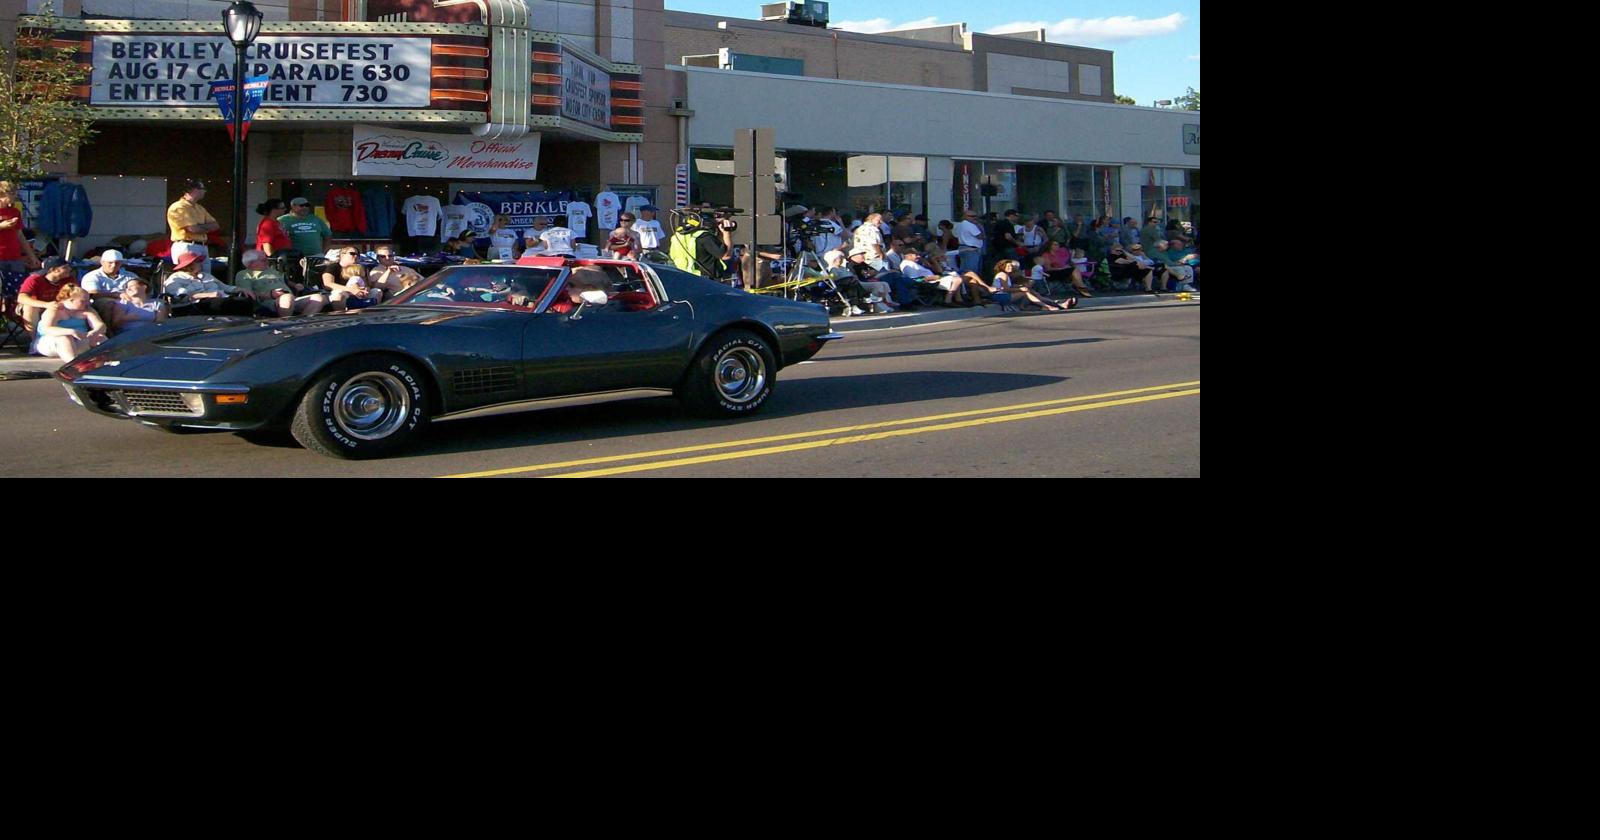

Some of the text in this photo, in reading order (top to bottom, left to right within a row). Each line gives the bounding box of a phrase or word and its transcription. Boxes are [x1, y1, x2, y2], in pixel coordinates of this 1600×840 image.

[111, 42, 394, 61] BERKLEY CRUISEFEST
[108, 62, 159, 80] AUG
[167, 63, 189, 80] 17
[253, 64, 354, 81] PARADE
[362, 64, 410, 82] 630
[109, 83, 316, 101] ENTERTENT
[341, 85, 388, 102] 730
[470, 140, 523, 155] Official
[446, 156, 536, 169] Merchandise
[500, 200, 569, 215] BERKLE
[389, 364, 421, 400] RADIAL
[322, 381, 359, 448] SUPER STAR
